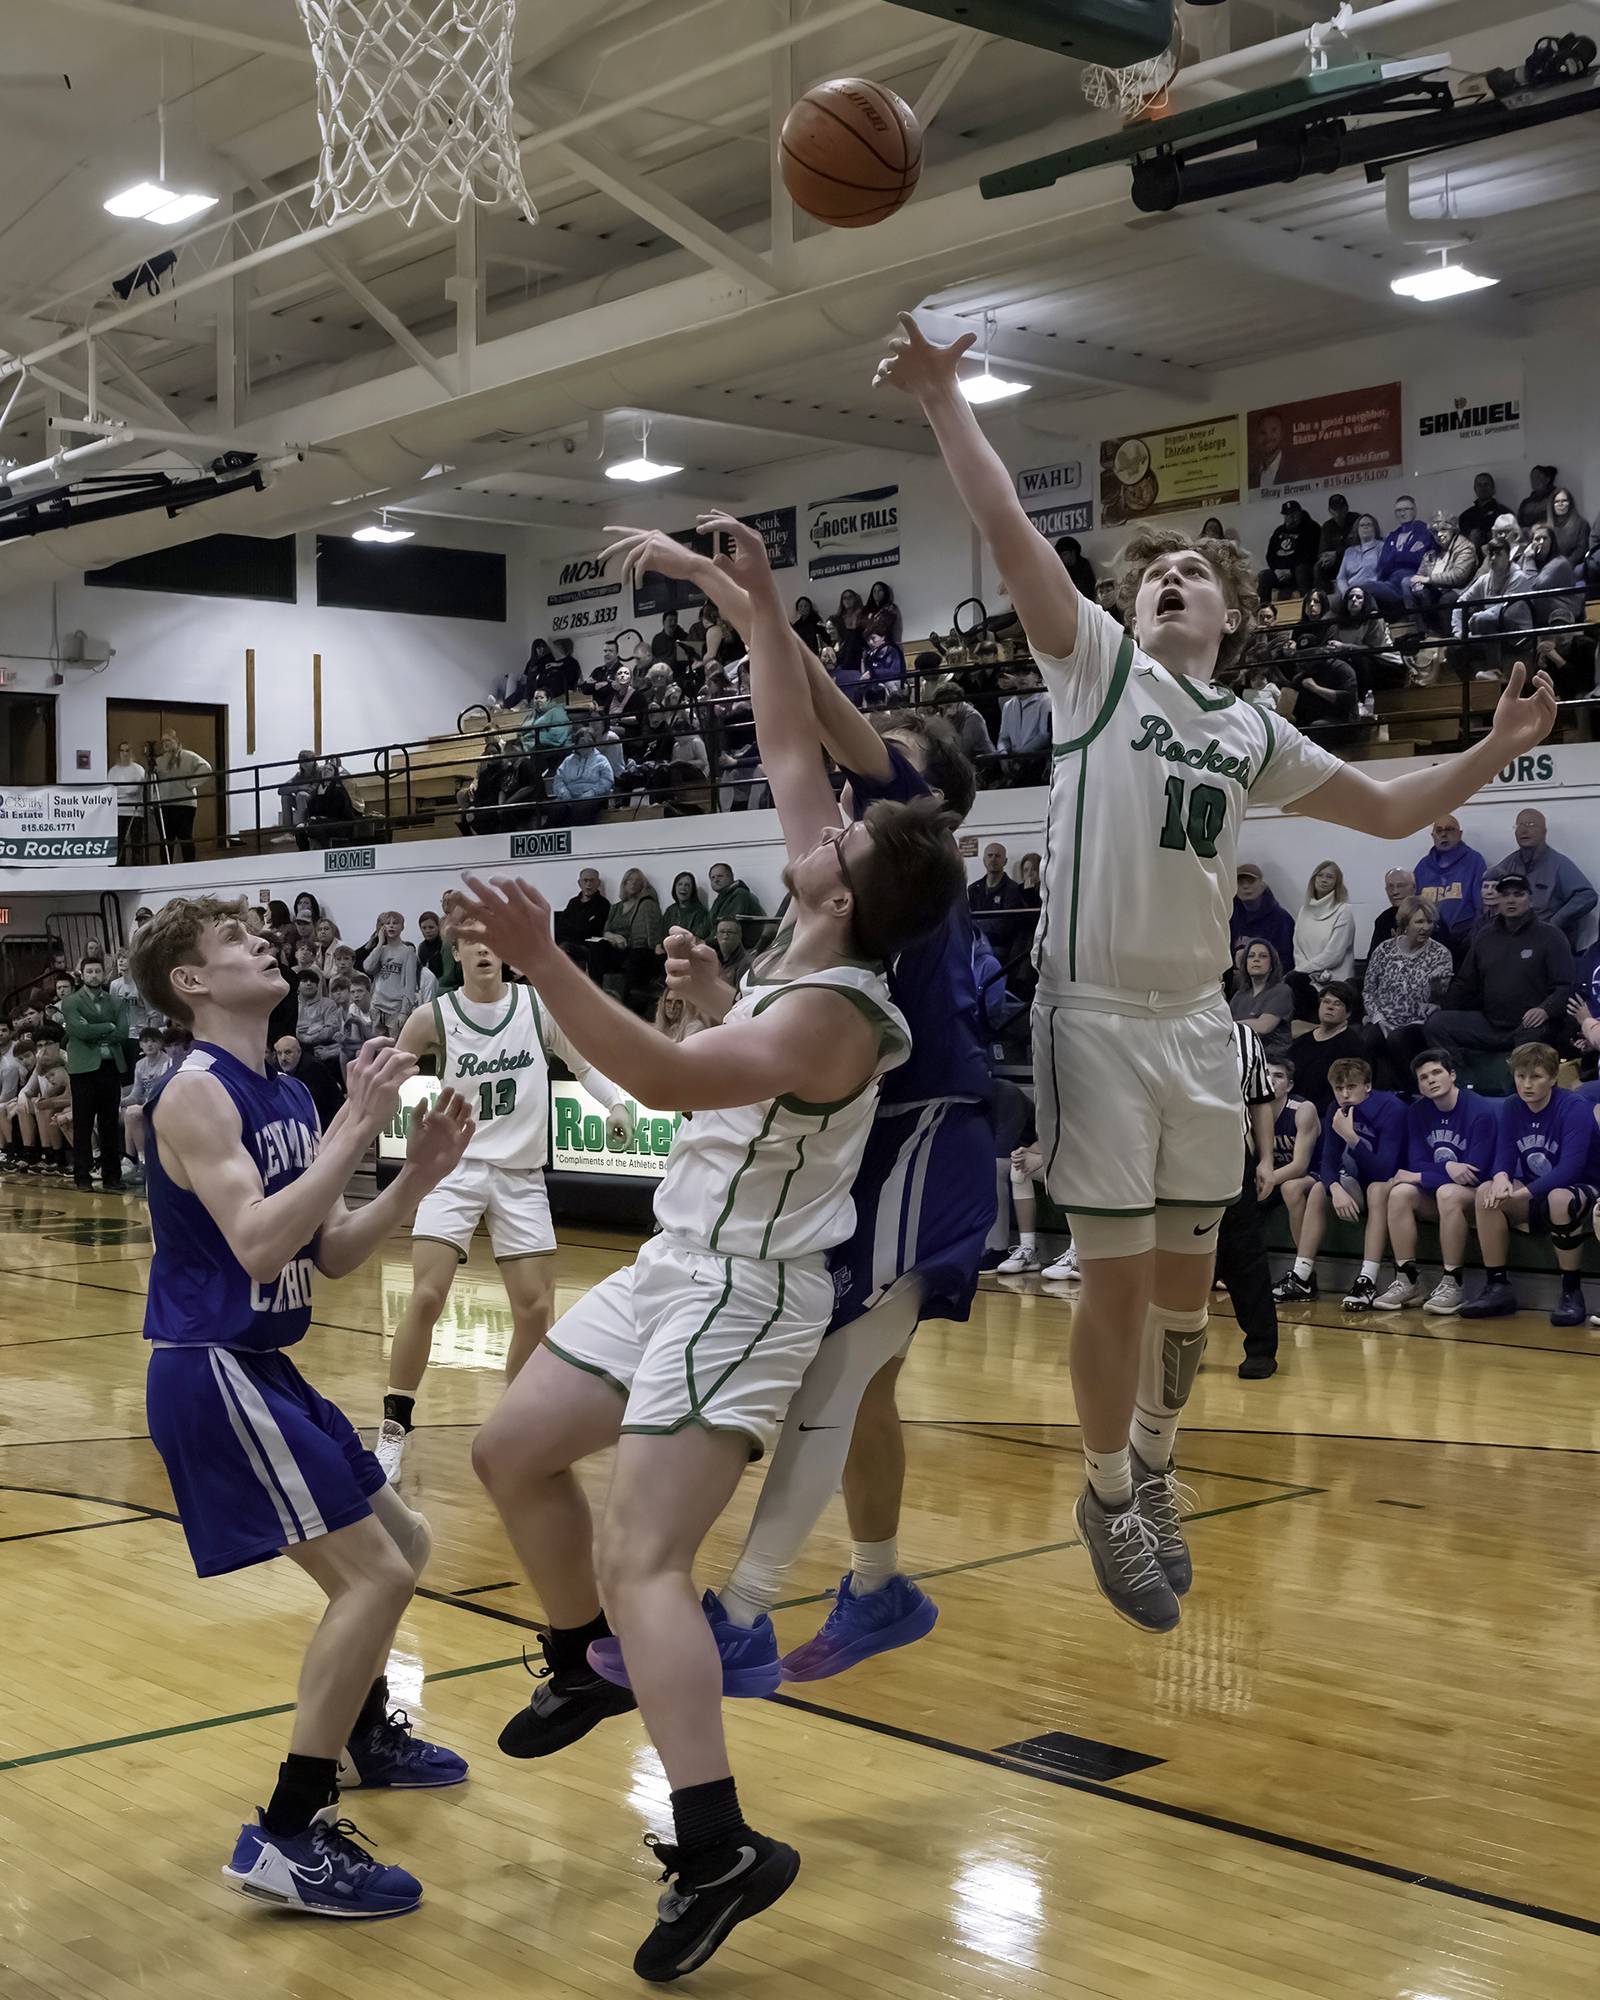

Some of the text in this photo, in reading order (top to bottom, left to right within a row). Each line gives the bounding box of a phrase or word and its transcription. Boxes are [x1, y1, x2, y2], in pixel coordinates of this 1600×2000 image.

[1420, 401, 1520, 436] SAMUEL
[1319, 428, 1342, 441] Farm
[1024, 467, 1074, 491] WAHL
[1284, 483, 1311, 495] Brown
[755, 515, 780, 530] Sauk
[823, 515, 857, 538] ROCK
[861, 507, 898, 531] FALLS
[763, 529, 788, 545] alley
[768, 544, 781, 558] nk
[54, 795, 79, 805] Sauk
[82, 795, 113, 806] Valley
[12, 810, 43, 819] Estate
[54, 808, 85, 819] Realty
[1159, 775, 1227, 858] 10
[21, 823, 75, 832] 815.626.1771
[24, 840, 109, 857] Rockets!
[514, 832, 568, 857] HOME
[328, 850, 372, 870] HOME
[455, 1049, 535, 1078] Rockets
[479, 1078, 516, 1121] 13
[606, 1157, 613, 1166] of
[615, 1157, 627, 1167] the
[629, 1159, 657, 1170] Athletic
